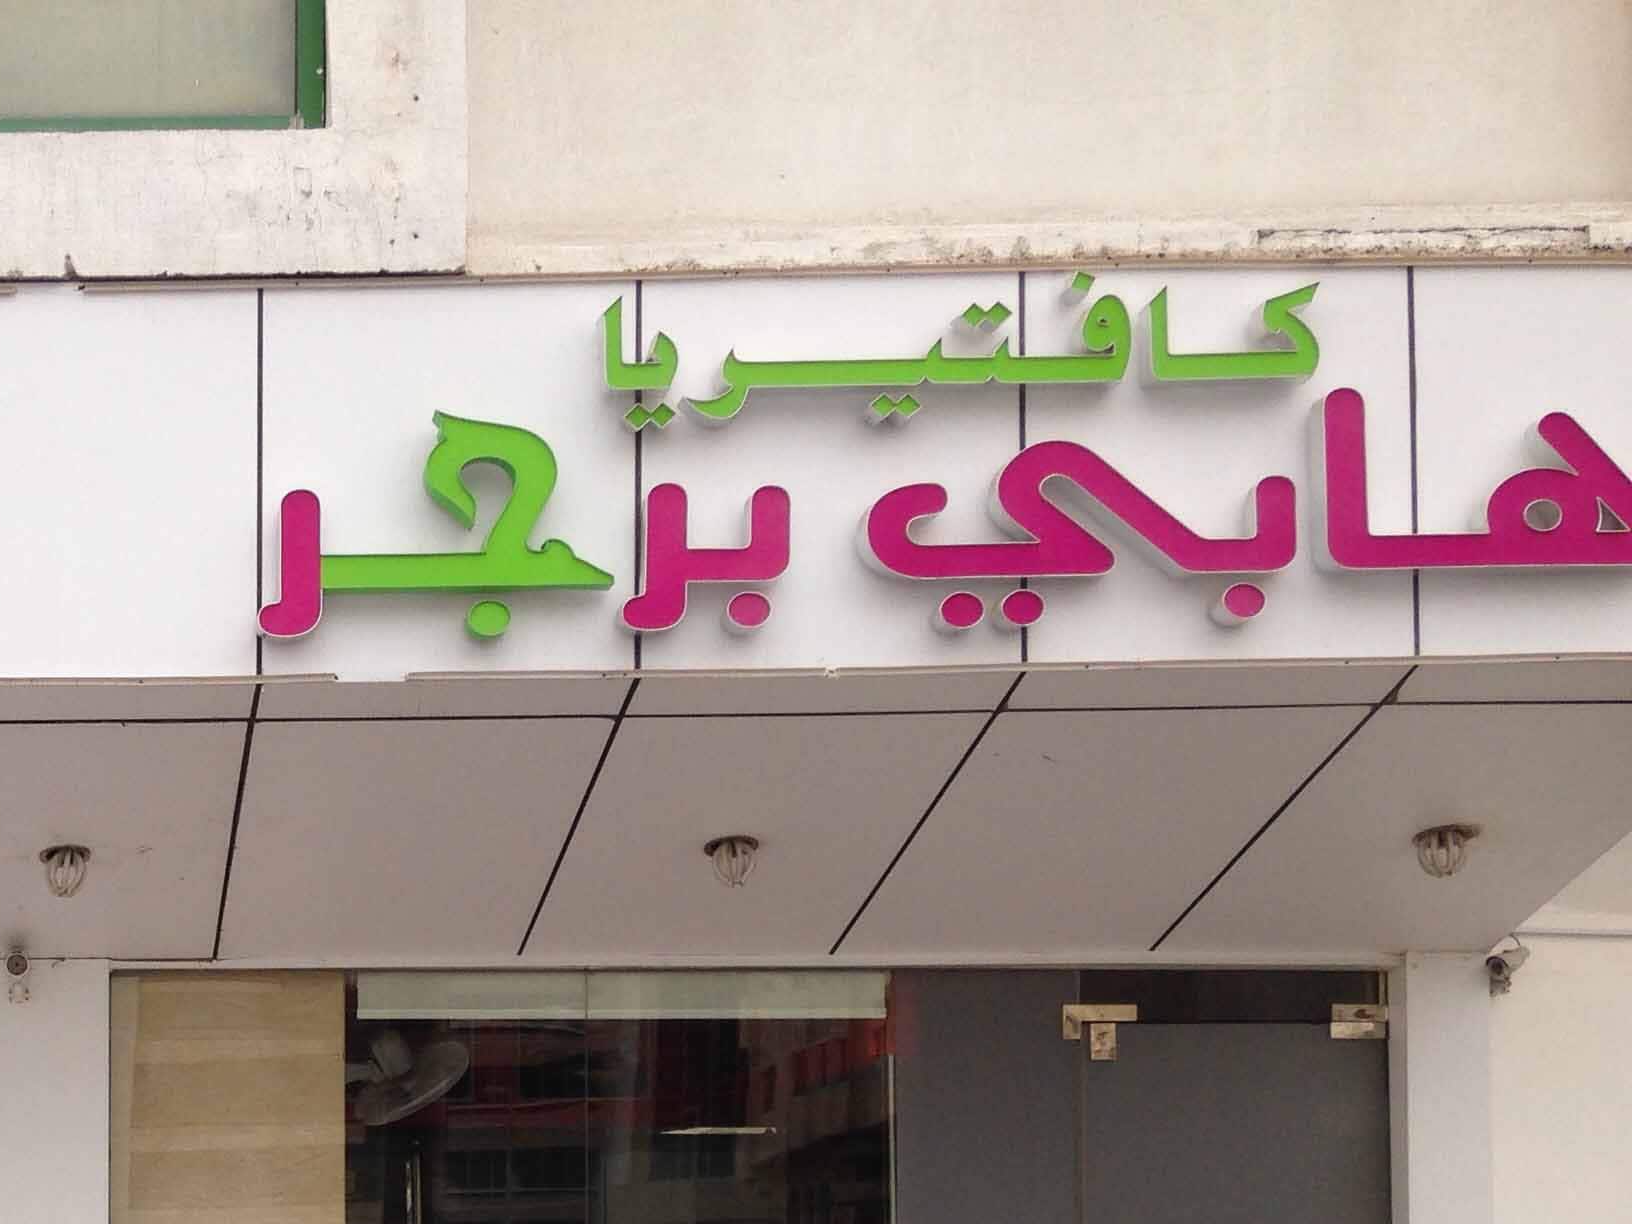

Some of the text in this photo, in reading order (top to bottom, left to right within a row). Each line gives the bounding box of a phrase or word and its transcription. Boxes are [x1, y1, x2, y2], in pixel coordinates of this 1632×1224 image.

[605, 270, 1319, 428] كافتيريا
[256, 387, 1632, 640] هابي برجر
